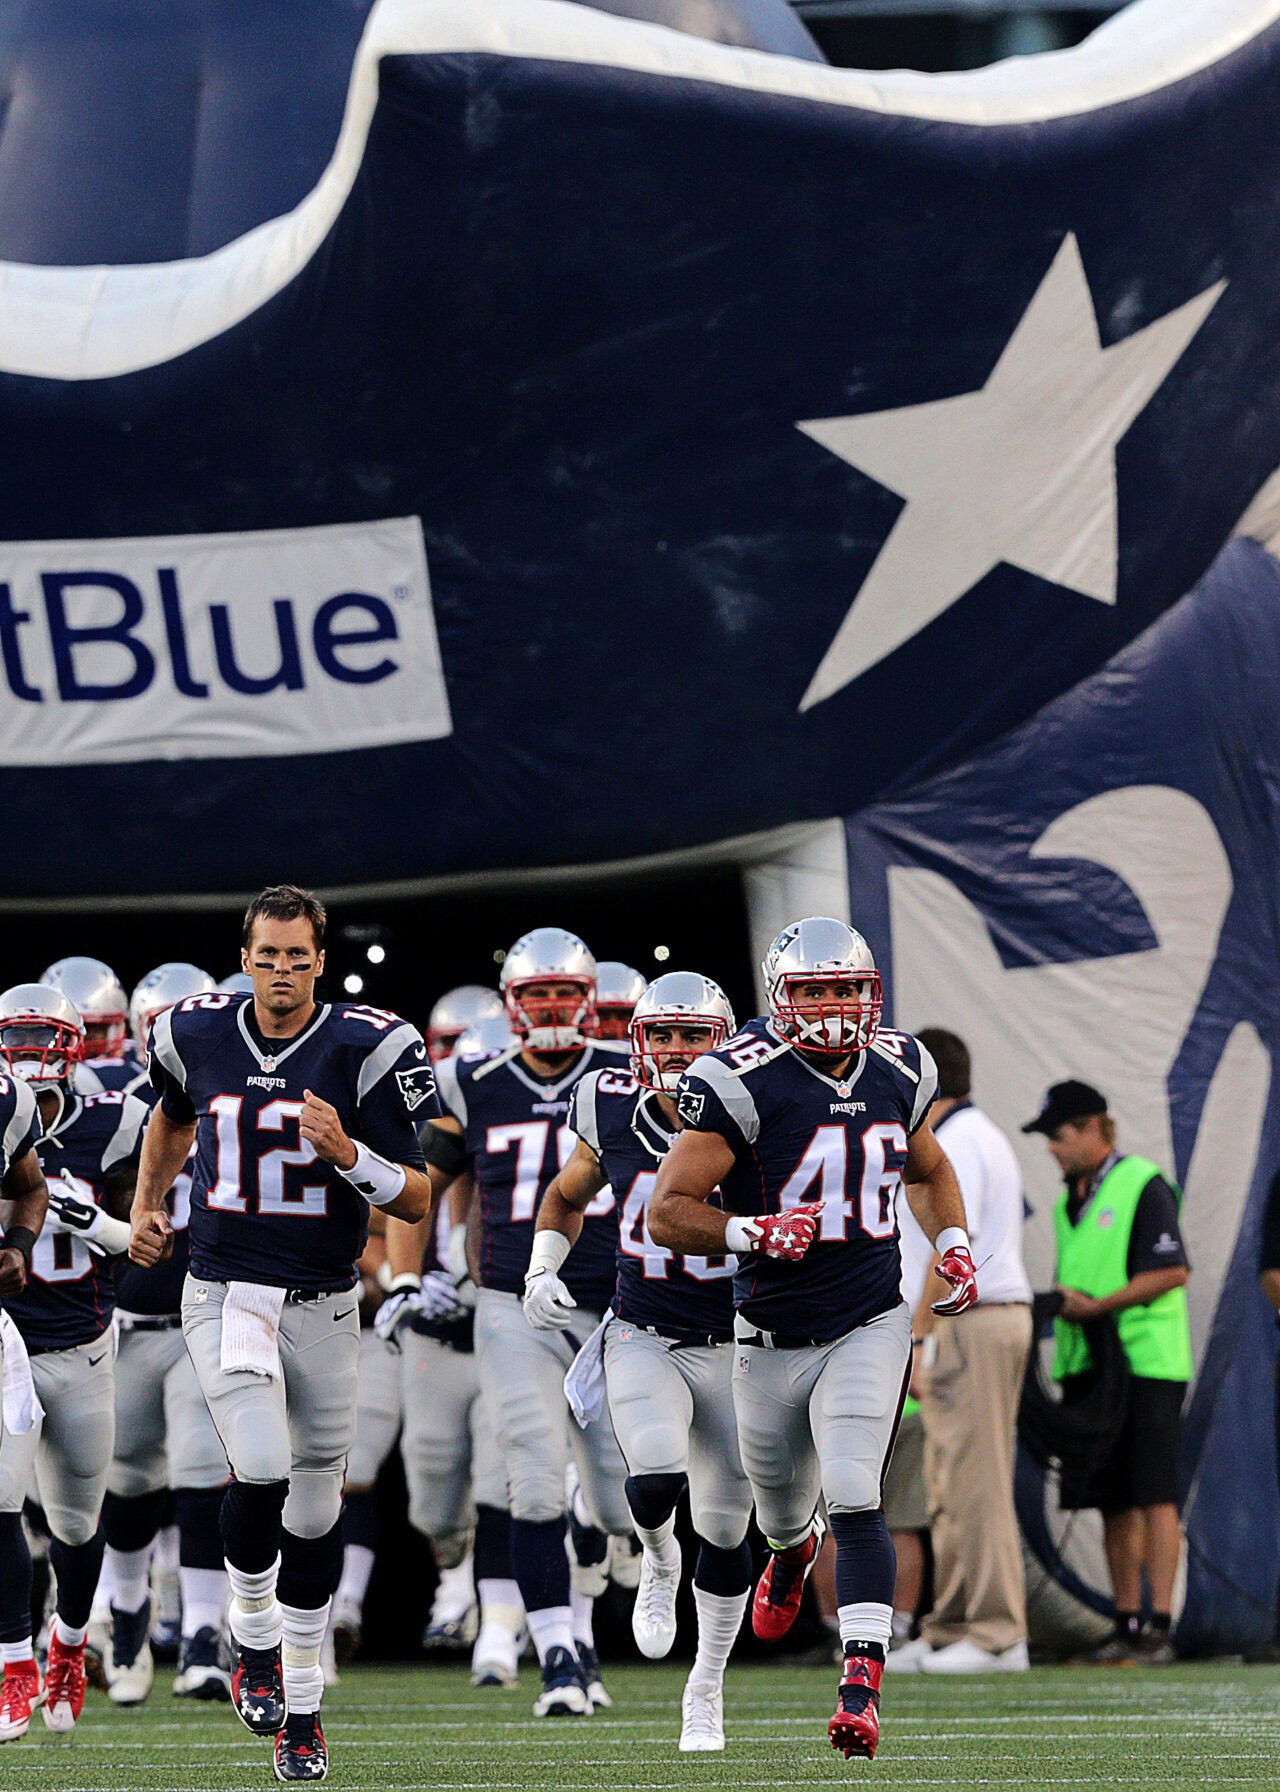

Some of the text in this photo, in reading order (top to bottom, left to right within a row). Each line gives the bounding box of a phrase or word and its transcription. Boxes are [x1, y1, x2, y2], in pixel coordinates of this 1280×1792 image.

[246, 1076, 287, 1090] PATRIOTS
[829, 1102, 867, 1115] PATRIOTS
[206, 1093, 330, 1217] 12
[778, 1121, 909, 1242] 46
